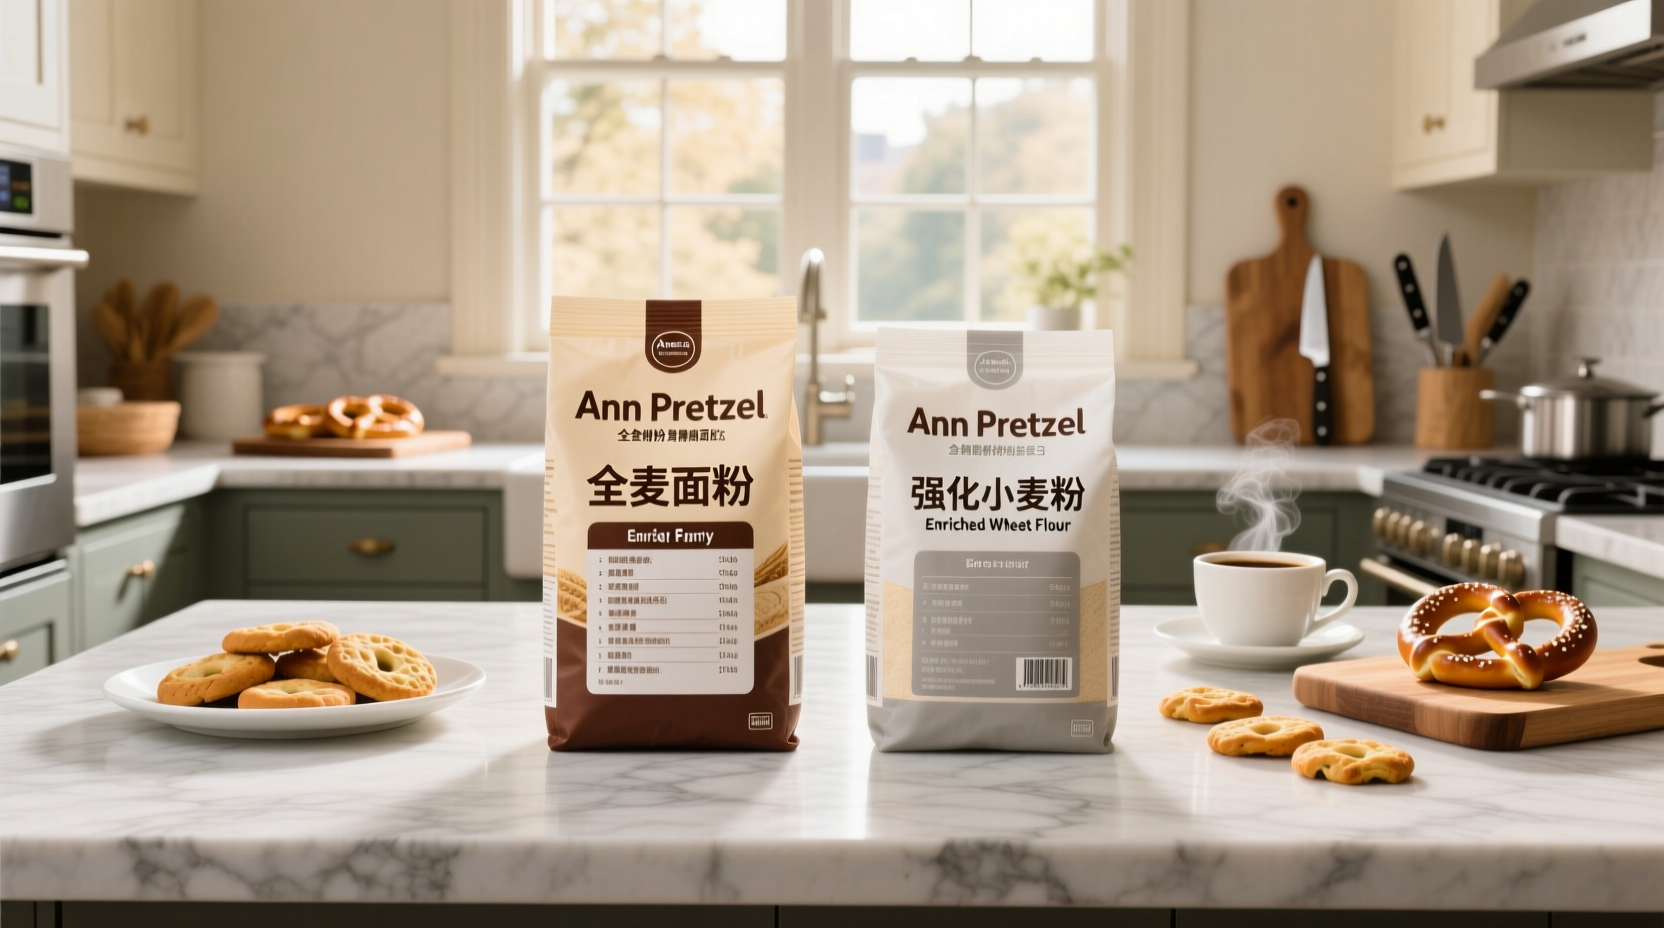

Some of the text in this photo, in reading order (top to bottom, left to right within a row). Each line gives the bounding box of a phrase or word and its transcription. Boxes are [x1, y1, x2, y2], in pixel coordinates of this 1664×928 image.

[574, 389, 766, 422] Ann Pretzel
[907, 407, 1086, 438] Ann Pretzel
[586, 464, 754, 508] 全麦面粉
[911, 475, 1086, 512] 强化小麦粉
[925, 516, 986, 531] Enriched
[1035, 517, 1072, 532] Flour
